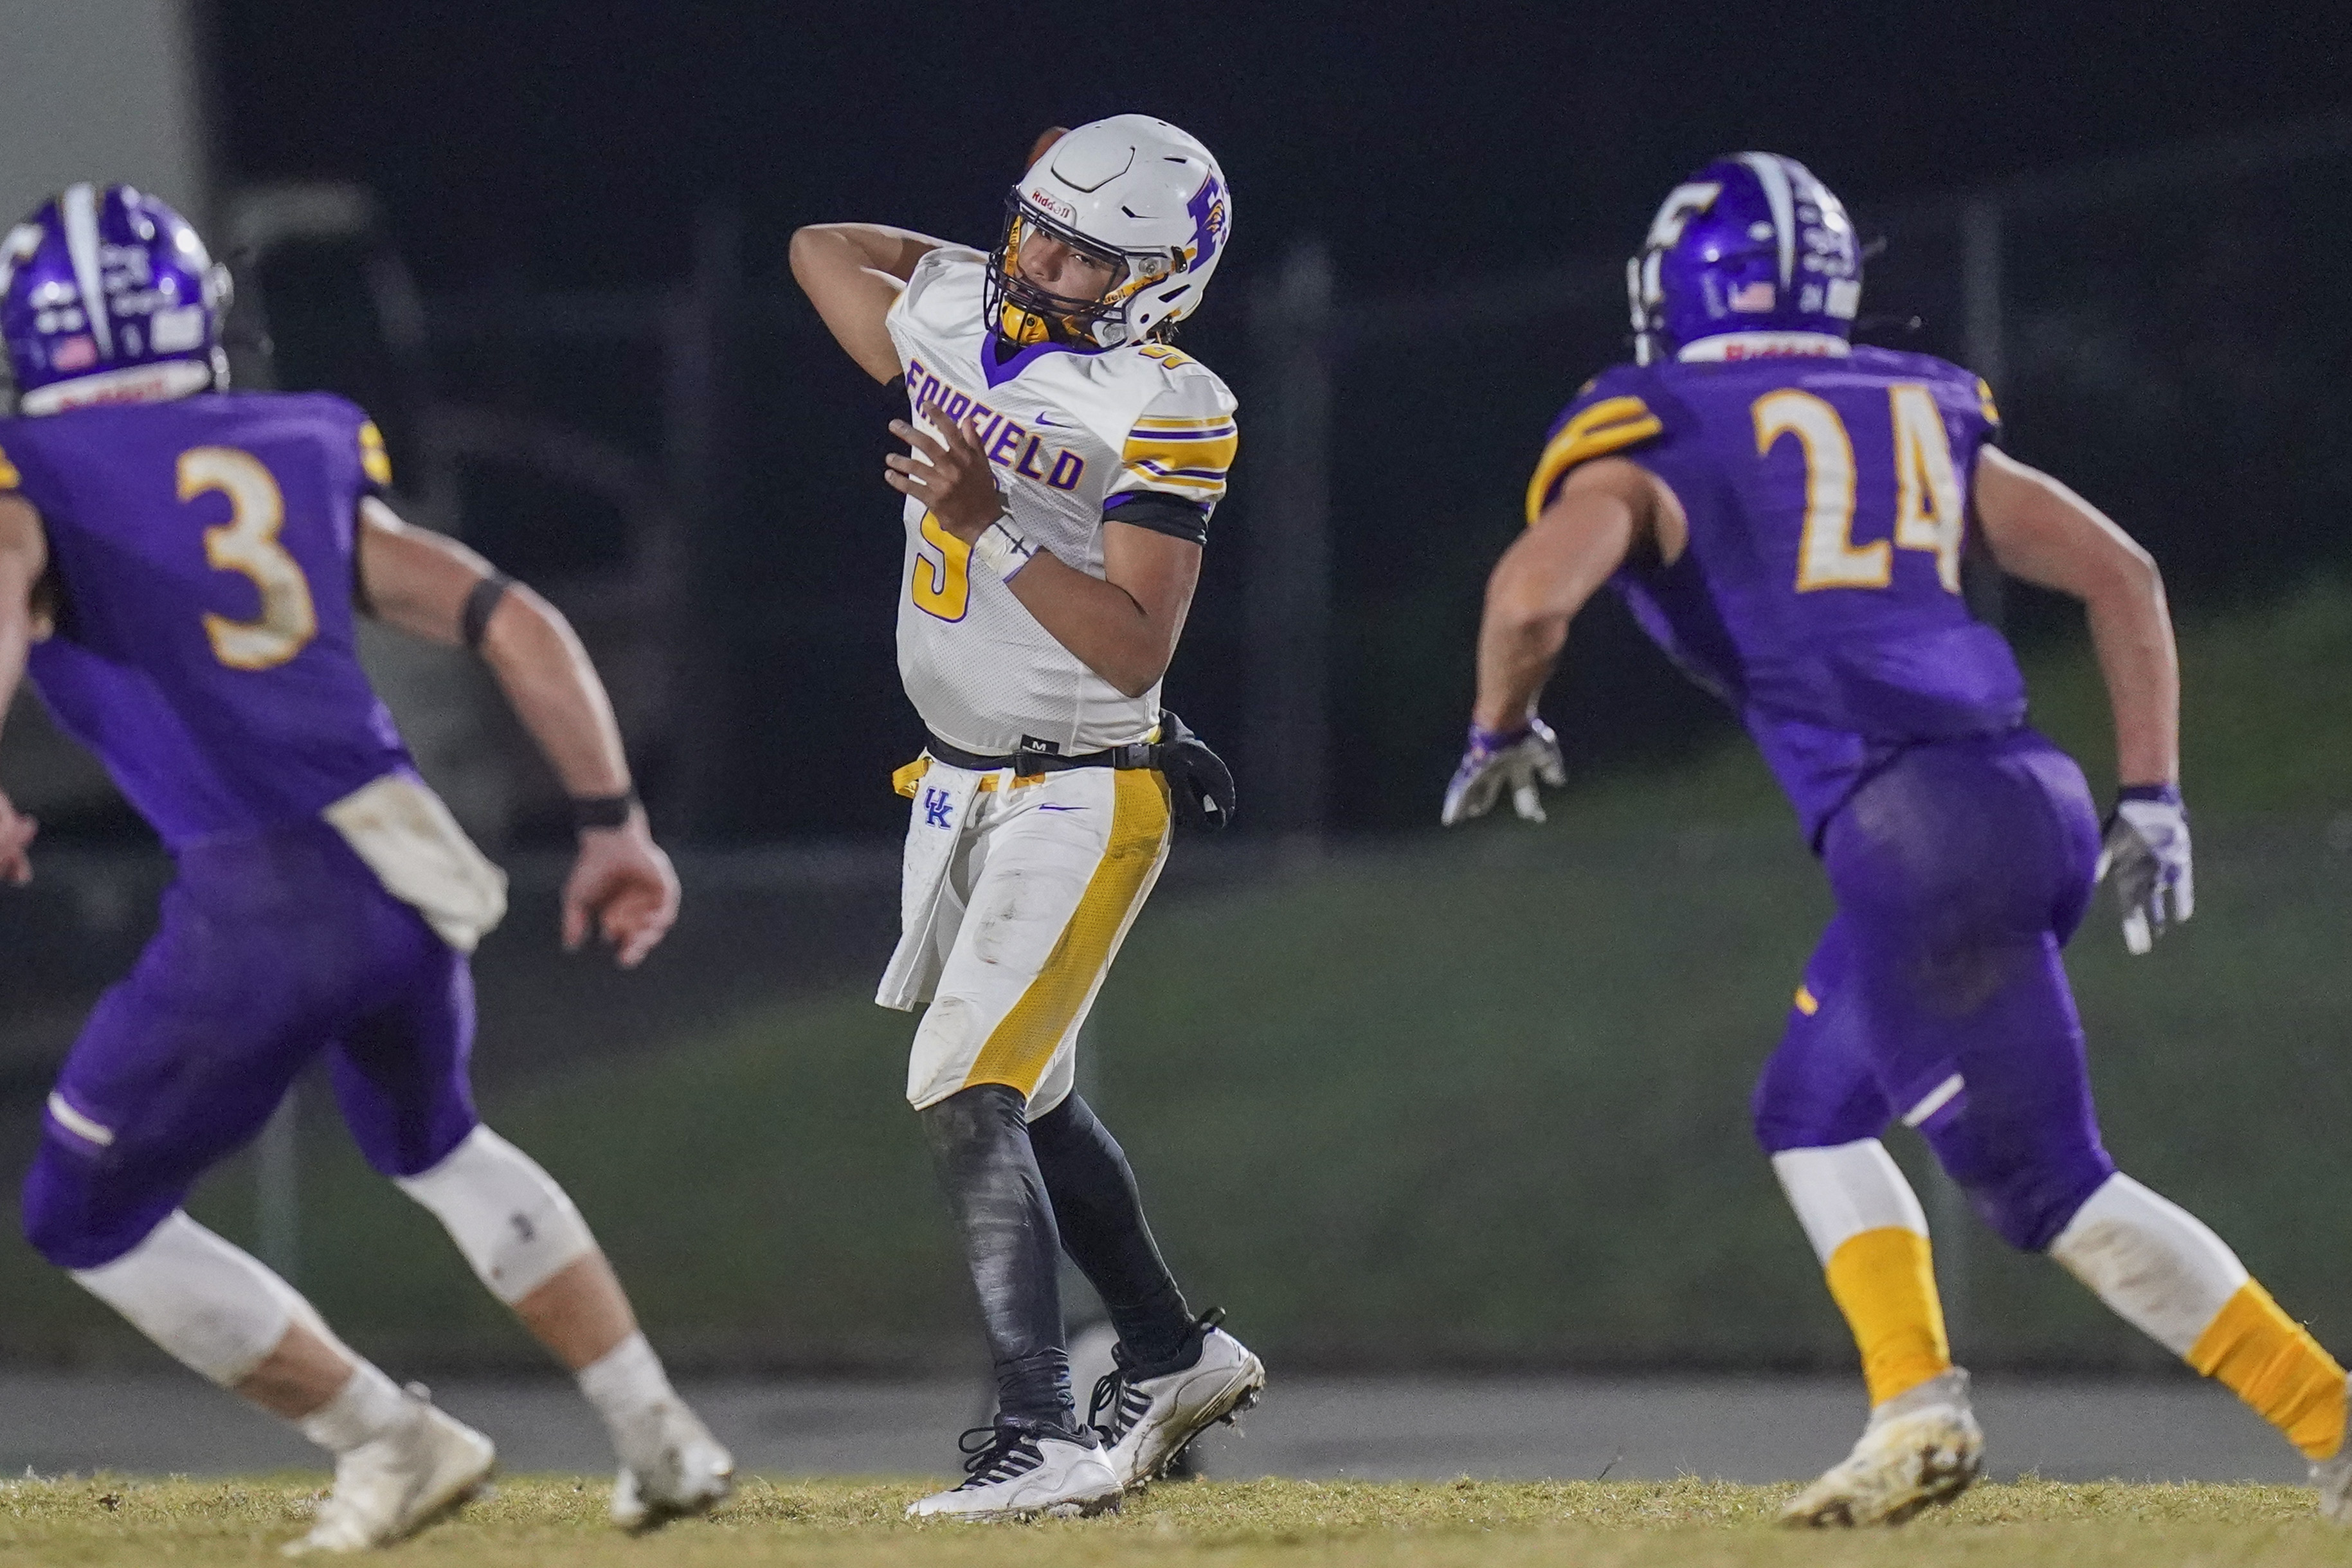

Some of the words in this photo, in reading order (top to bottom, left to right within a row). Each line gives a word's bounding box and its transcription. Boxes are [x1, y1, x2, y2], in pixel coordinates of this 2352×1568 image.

[1032, 190, 1070, 219] Riddell
[1750, 384, 1965, 594] 24
[175, 444, 319, 672] 3
[1032, 741, 1047, 752] M
[924, 786, 954, 830] UK
